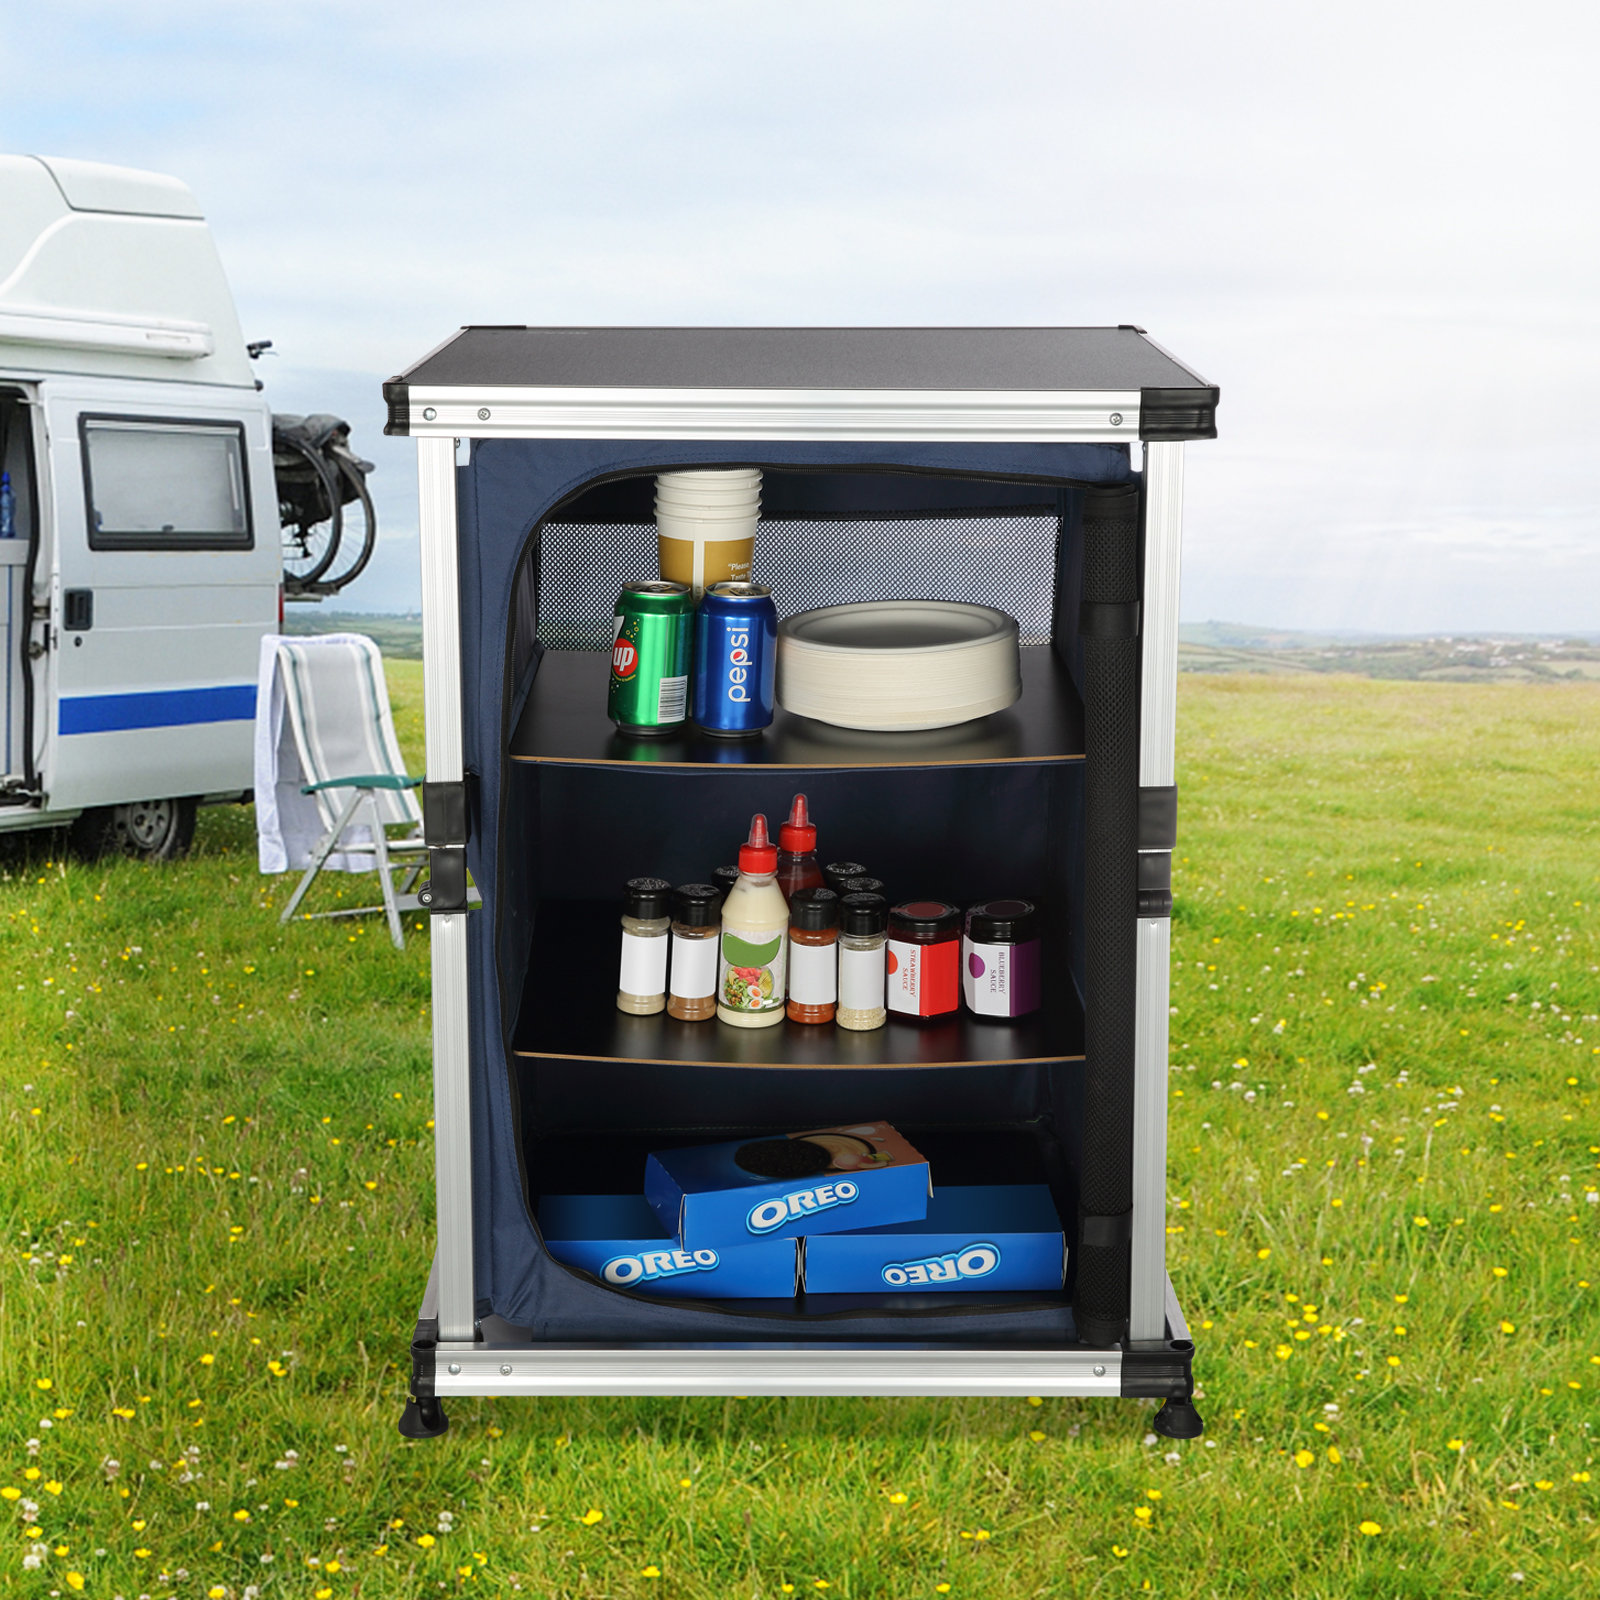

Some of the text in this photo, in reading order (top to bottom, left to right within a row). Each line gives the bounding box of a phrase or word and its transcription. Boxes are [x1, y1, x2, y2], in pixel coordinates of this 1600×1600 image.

[726, 626, 752, 702] pepsi
[750, 1182, 857, 1229] OREO
[603, 1249, 717, 1285] OREO
[884, 1248, 996, 1285] OREO
